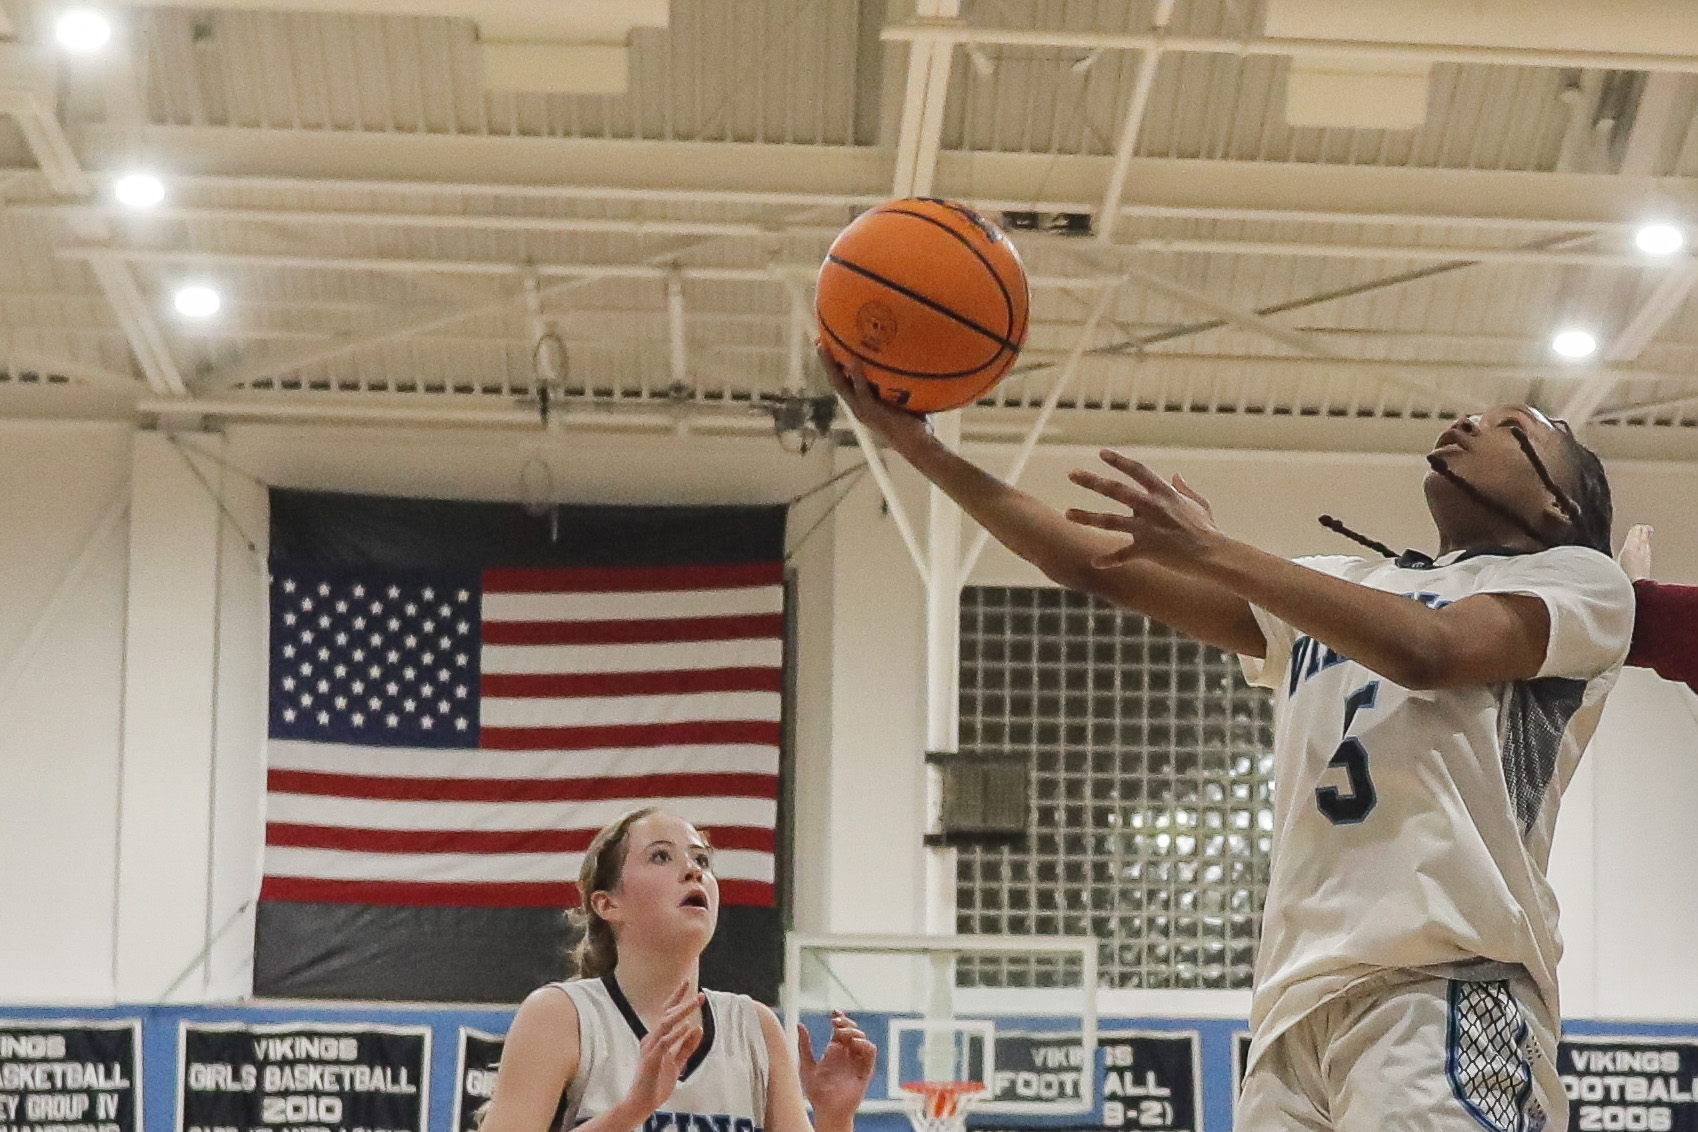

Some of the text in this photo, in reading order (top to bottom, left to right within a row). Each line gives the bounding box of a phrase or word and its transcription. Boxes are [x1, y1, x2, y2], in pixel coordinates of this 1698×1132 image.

[254, 1037, 358, 1062] VIKINGS
[1570, 1050, 1680, 1073] VIKINGS
[0, 1061, 130, 1089] SKETBALL
[188, 1062, 416, 1094] GIRLS BASKETBALL
[26, 1093, 90, 1121] GROUP
[262, 1095, 343, 1124] 2010
